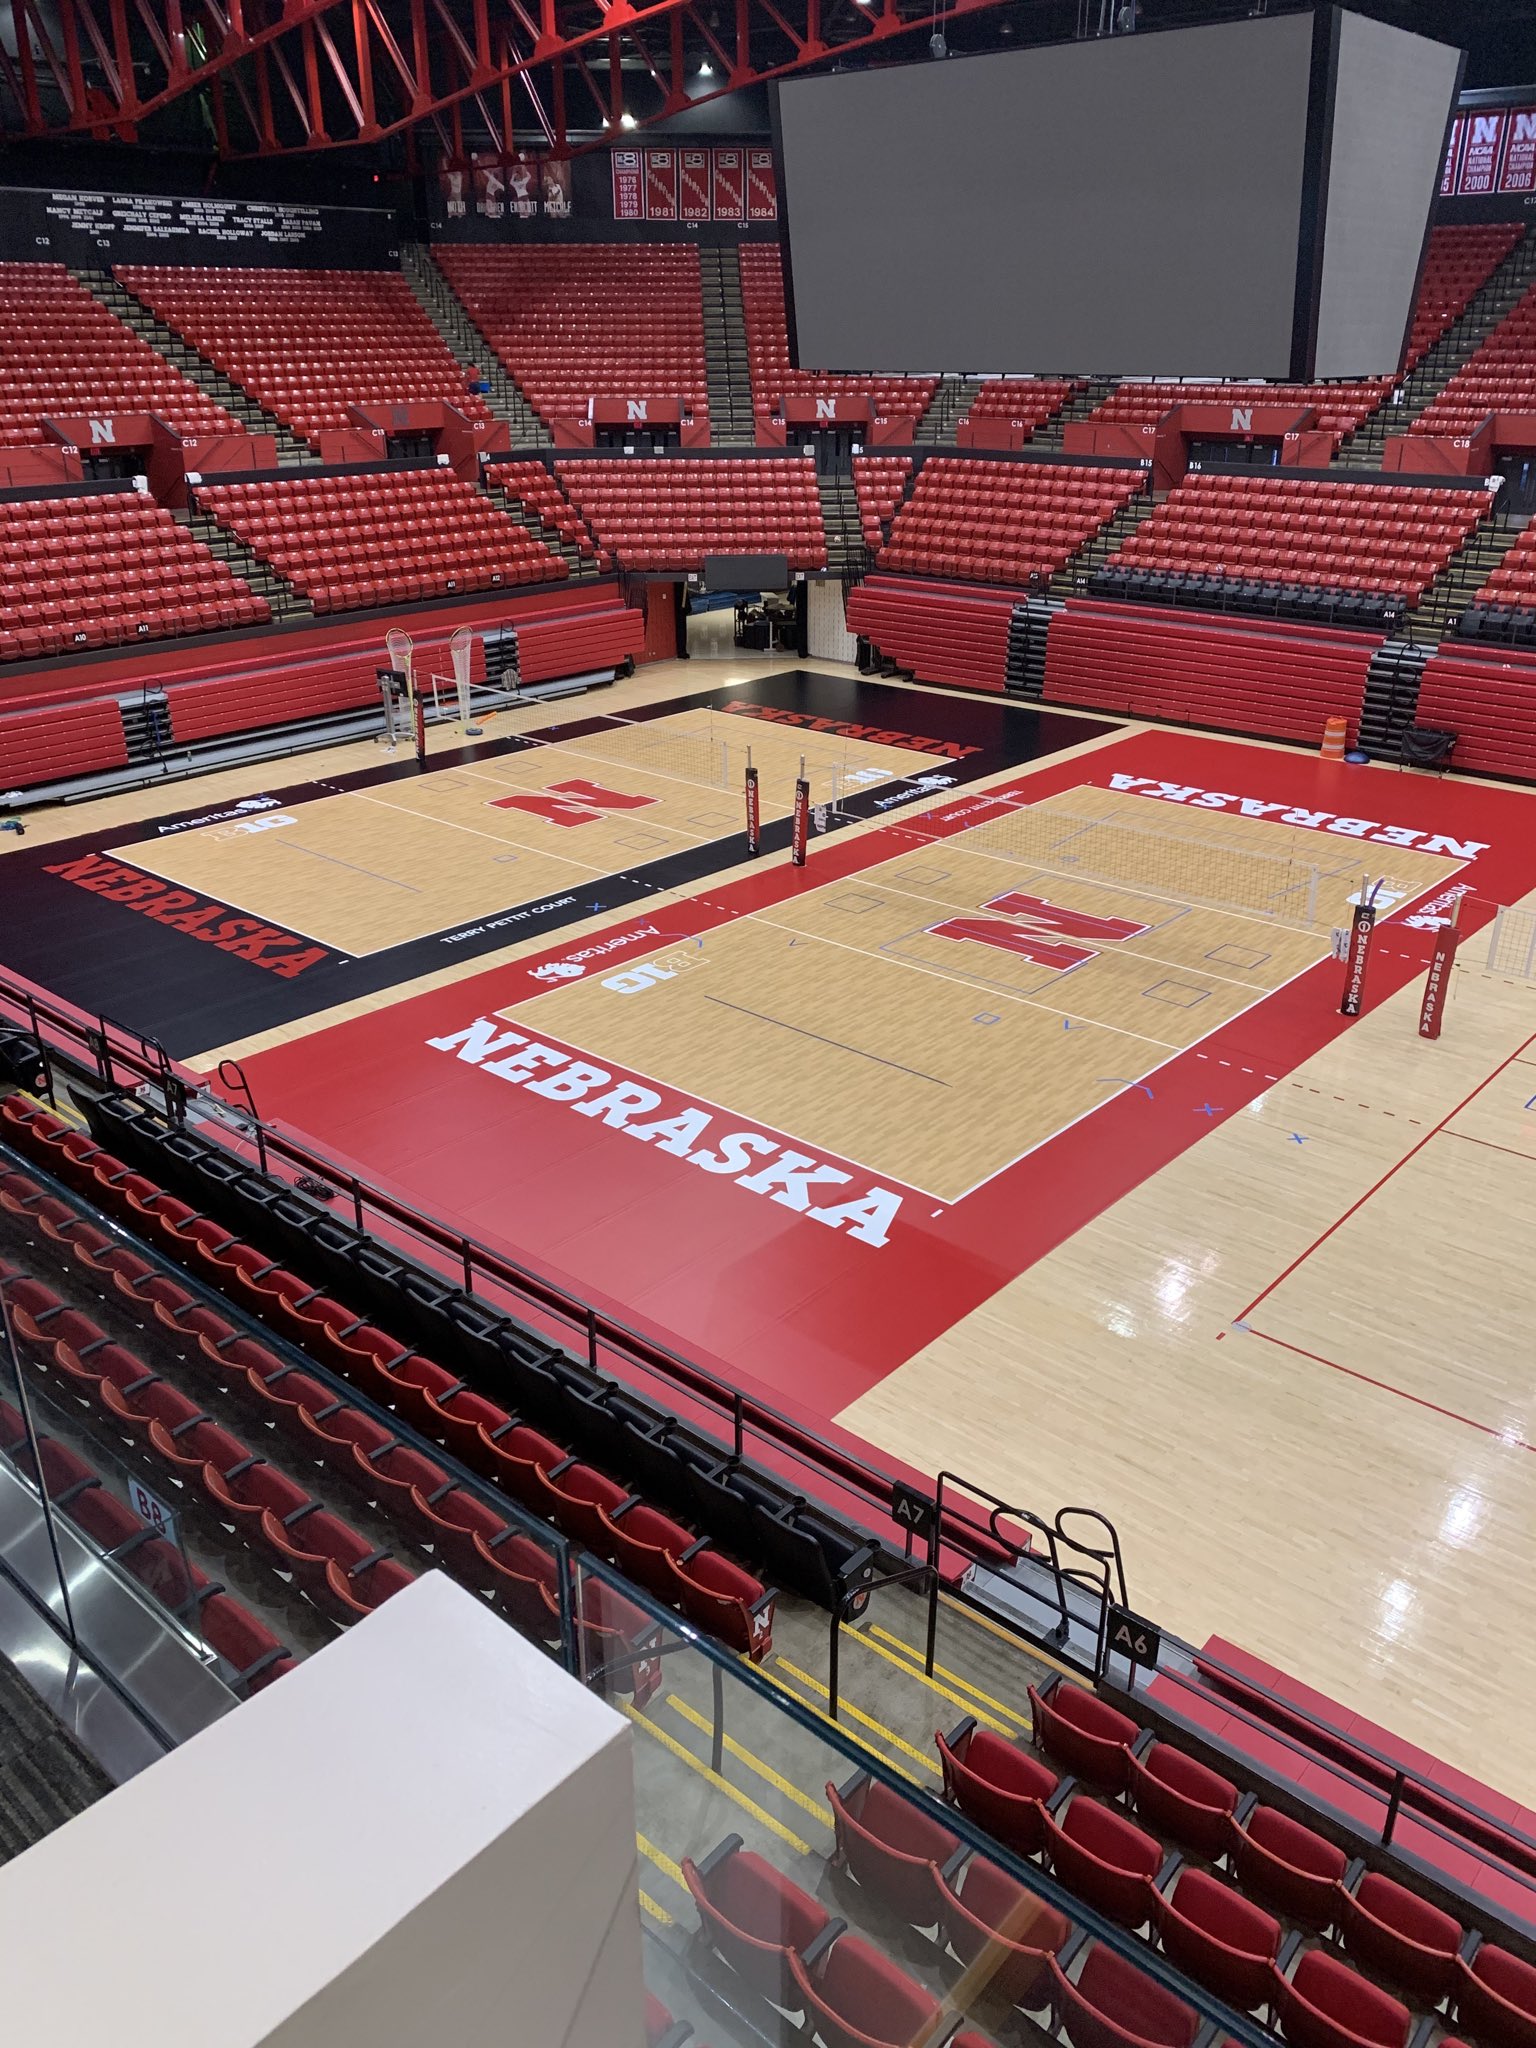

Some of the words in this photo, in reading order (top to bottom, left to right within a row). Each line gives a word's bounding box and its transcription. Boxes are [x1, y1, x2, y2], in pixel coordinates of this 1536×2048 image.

[1471, 116, 1500, 144] N
[1468, 146, 1494, 156] NCAA
[1510, 143, 1536, 153] NCAA
[1464, 175, 1490, 190] 2000
[1504, 172, 1532, 188] 2006
[649, 207, 674, 217] 1981
[683, 207, 708, 217] 1982
[716, 207, 741, 217] 1983
[750, 207, 774, 217] 1984
[35, 237, 50, 246] C12
[627, 400, 648, 420] N
[815, 398, 837, 419] N
[474, 422, 486, 430] C13
[772, 417, 786, 426] C15
[874, 417, 888, 425] C15
[958, 417, 970, 426] C16
[1011, 420, 1024, 429] C16
[1230, 408, 1253, 431] N
[89, 419, 116, 444] N
[1142, 426, 1156, 435] C17
[1284, 432, 1300, 441] C17
[61, 444, 79, 455] C12
[182, 438, 198, 448] C12
[1453, 439, 1471, 449] C18
[1140, 458, 1153, 468] B15
[1189, 460, 1202, 470] B16
[1383, 611, 1395, 619] A14
[138, 624, 149, 633] A11
[74, 633, 87, 643] A10
[721, 700, 985, 760] NEBRASKA
[483, 777, 664, 830] N
[157, 807, 248, 835] Ameritas
[747, 789, 756, 852] NEBRASKA
[1108, 772, 1492, 860] NEBRASKA
[792, 802, 803, 864] NEBRASKA
[41, 855, 330, 979] NEBRASKA
[440, 925, 487, 946] TERRY
[485, 910, 532, 930] PETTIT
[531, 895, 578, 915] COURT
[922, 890, 1154, 973] N
[566, 925, 661, 964] Ameritas
[1346, 934, 1368, 1013] NEBRASKA
[1421, 951, 1446, 1032] NEBRASKA
[166, 1080, 178, 1096] A7
[424, 1017, 904, 1249] NEBRASKA
[897, 1499, 925, 1525] A7
[753, 1604, 771, 1639] N
[1114, 1624, 1148, 1655] A6
